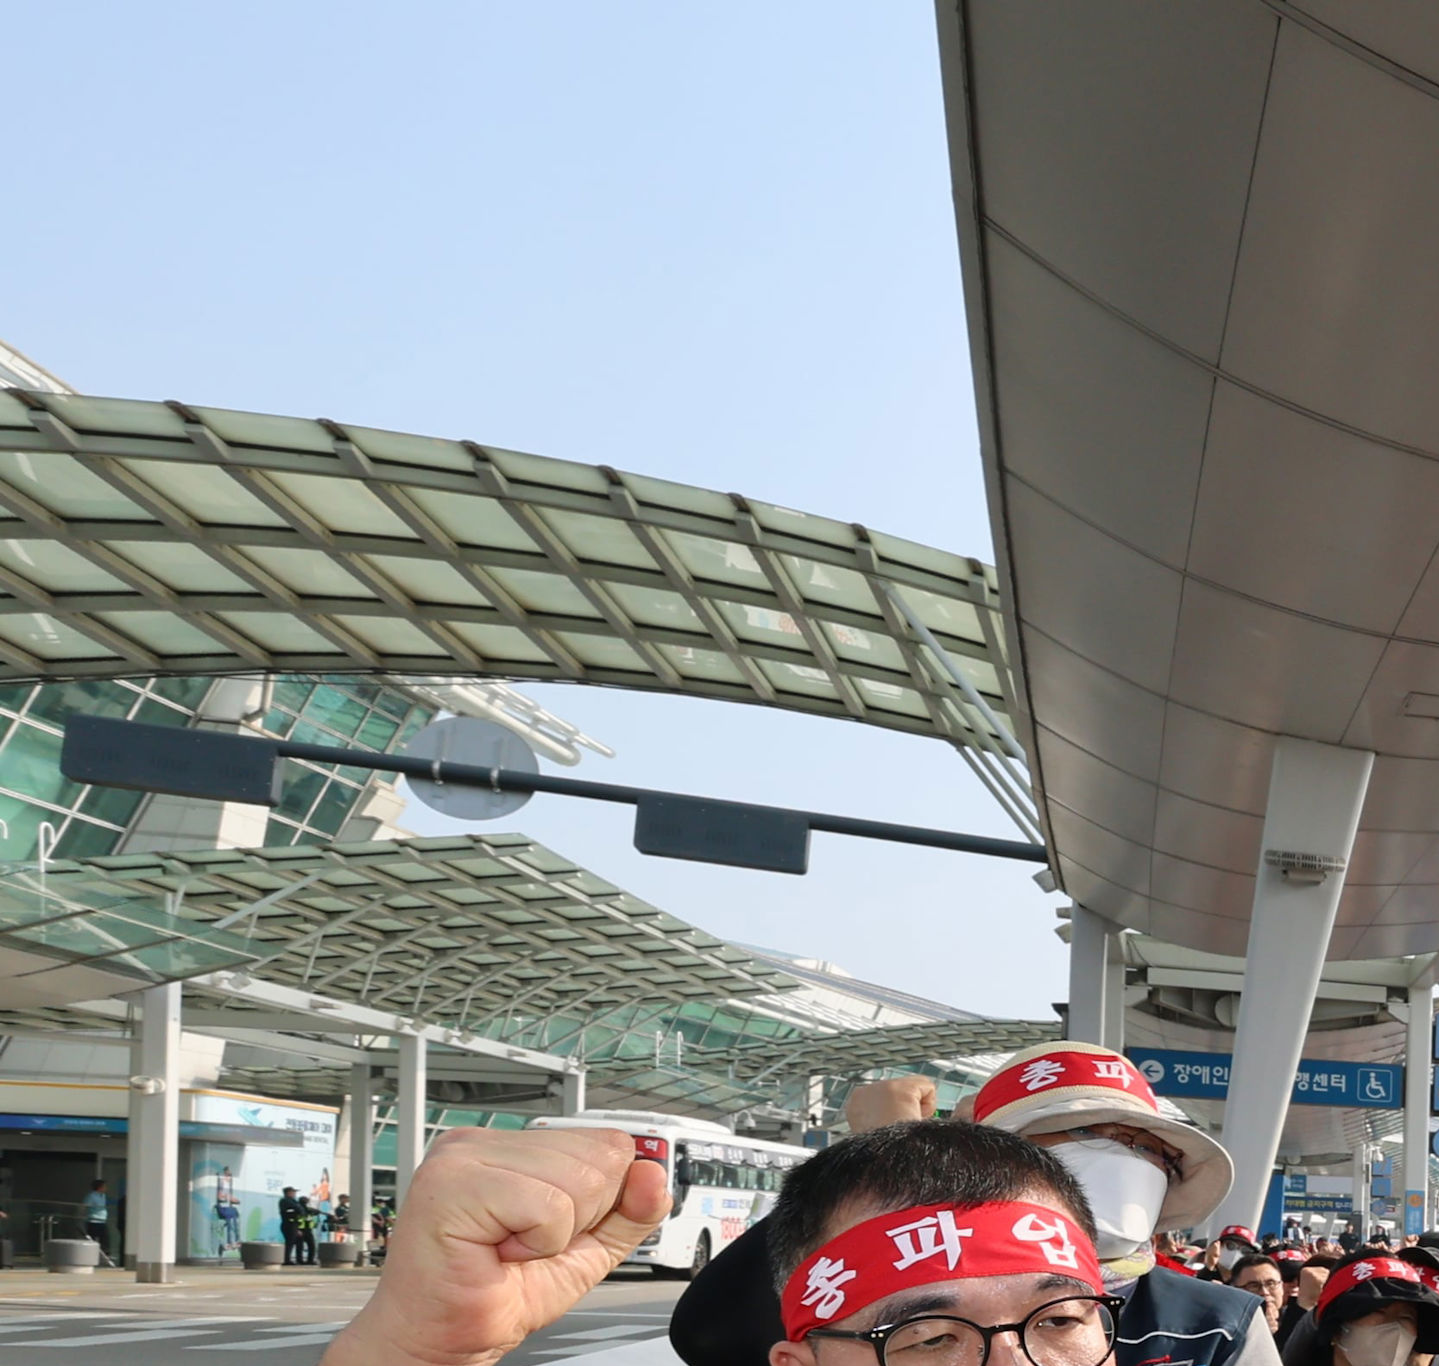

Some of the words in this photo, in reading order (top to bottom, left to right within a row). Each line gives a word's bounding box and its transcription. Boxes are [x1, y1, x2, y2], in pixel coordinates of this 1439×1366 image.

[1019, 1058, 1134, 1092] 총파
[1173, 1063, 1229, 1086] 장애인
[1294, 1071, 1347, 1093] 행센터
